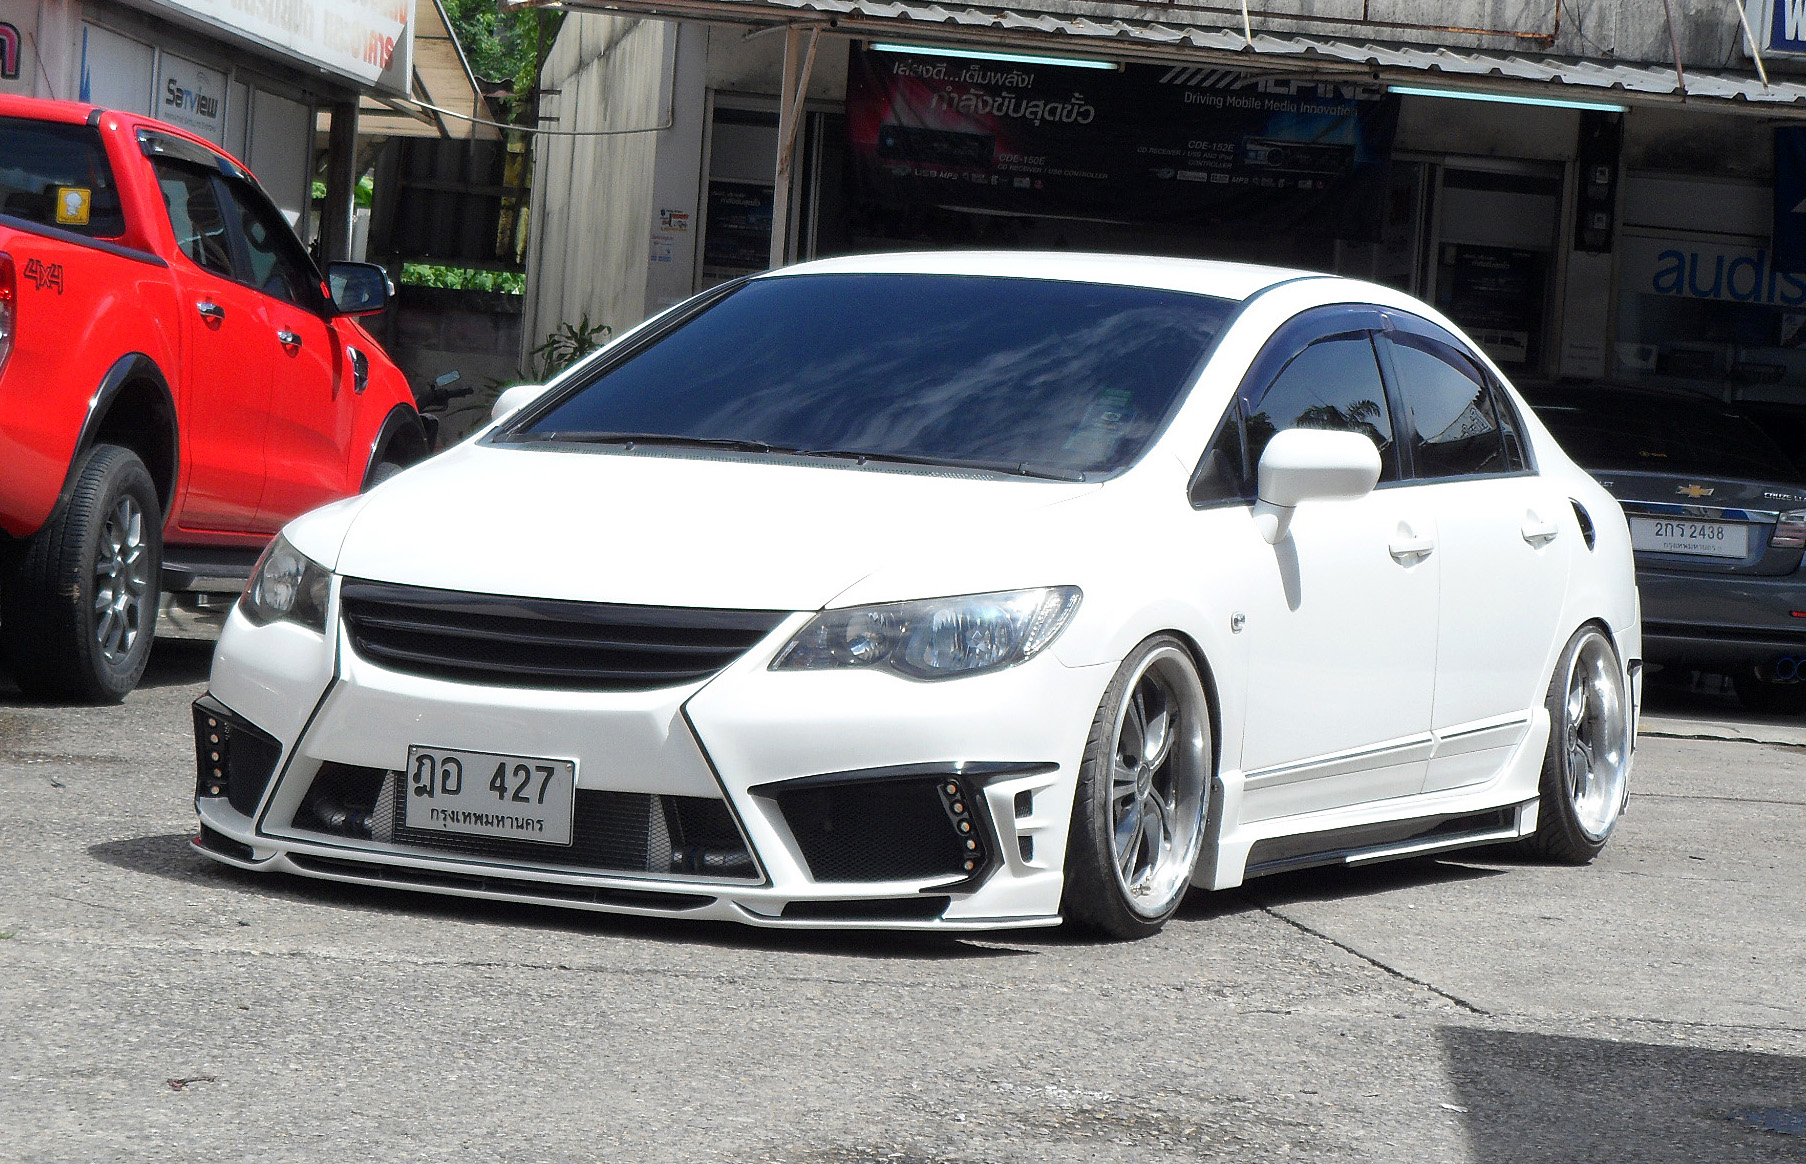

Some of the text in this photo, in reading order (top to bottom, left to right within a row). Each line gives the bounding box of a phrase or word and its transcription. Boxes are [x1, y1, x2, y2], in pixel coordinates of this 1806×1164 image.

[1184, 91, 1223, 109] Driving
[1226, 95, 1262, 110] Mobile
[1264, 98, 1297, 112] Media
[1188, 140, 1235, 153] CDE-152E
[1655, 522, 1724, 541] 2กร 2438
[489, 762, 555, 804] 427
[430, 808, 544, 832] กรุงเทพมหานคร
